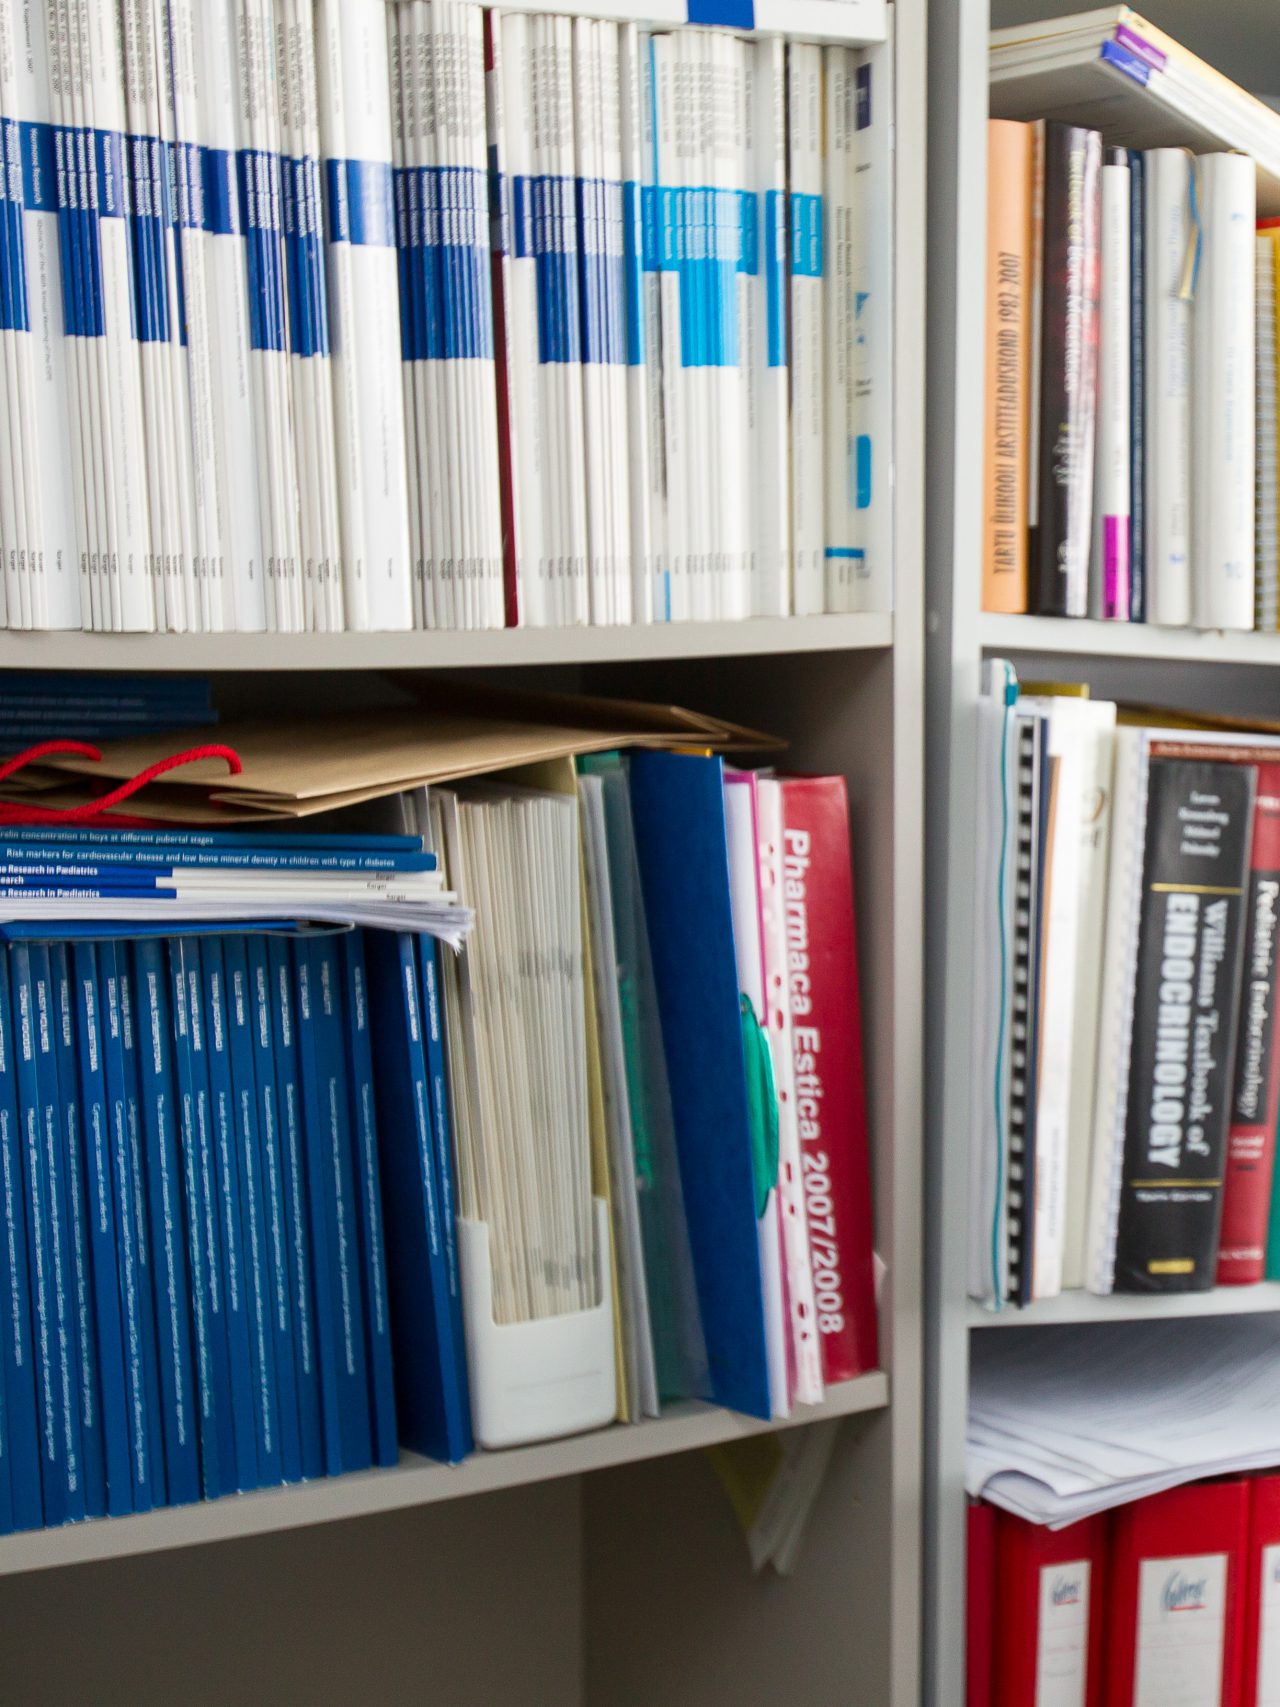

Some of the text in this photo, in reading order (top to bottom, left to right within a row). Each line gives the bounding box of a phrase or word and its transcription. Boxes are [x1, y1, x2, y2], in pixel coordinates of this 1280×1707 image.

[6, 847, 24, 858] Risk
[26, 849, 60, 859] markers
[62, 849, 74, 859] for
[76, 850, 133, 861] cardiovascular
[135, 852, 164, 862] disease
[165, 853, 180, 863] and
[182, 853, 197, 863] low
[199, 853, 219, 864] bone
[220, 854, 249, 865] mineral
[251, 854, 278, 867] density
[279, 855, 287, 865] in
[289, 855, 320, 866] children
[321, 856, 338, 866] with
[339, 857, 356, 868] type
[364, 857, 395, 867] diabetes
[80, 832, 88, 841] in
[120, 832, 154, 842] different
[155, 834, 188, 845] pubertal
[0, 875, 24, 885] earch
[8, 864, 45, 875] Research
[8, 888, 46, 898] Research
[1254, 880, 1280, 978] Pediatric
[1148, 893, 1199, 1168] ENDOCRINOLOGY
[1186, 901, 1228, 1157] Williams Textbook of
[1239, 980, 1271, 1120] Endocrinology
[783, 828, 846, 1335] Pharmaca Estica 2007/2008
